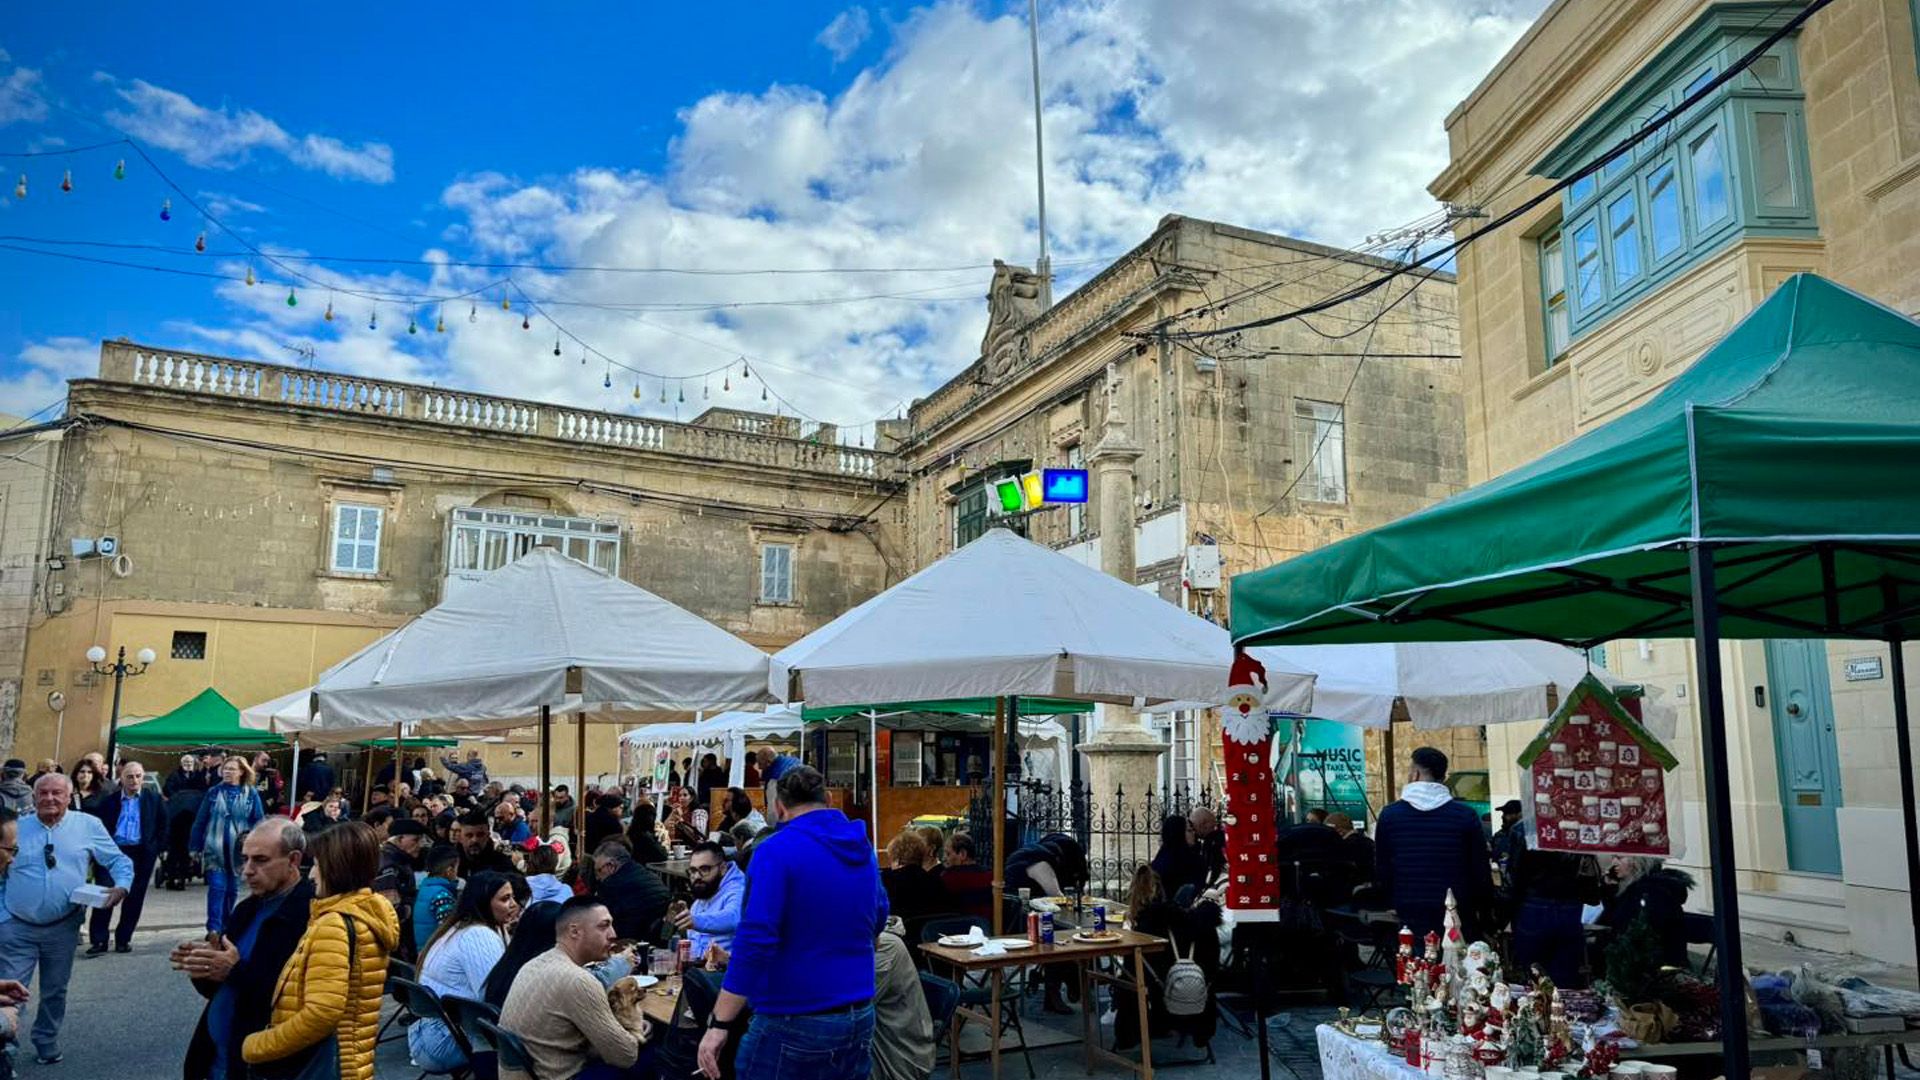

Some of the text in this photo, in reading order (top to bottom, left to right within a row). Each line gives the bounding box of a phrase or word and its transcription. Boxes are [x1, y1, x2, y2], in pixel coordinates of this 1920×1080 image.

[1316, 748, 1361, 762] MUSIC
[1325, 763, 1344, 771] TAKE
[1232, 773, 1240, 781] 2
[1252, 833, 1260, 841] 11
[1239, 895, 1250, 904] 22
